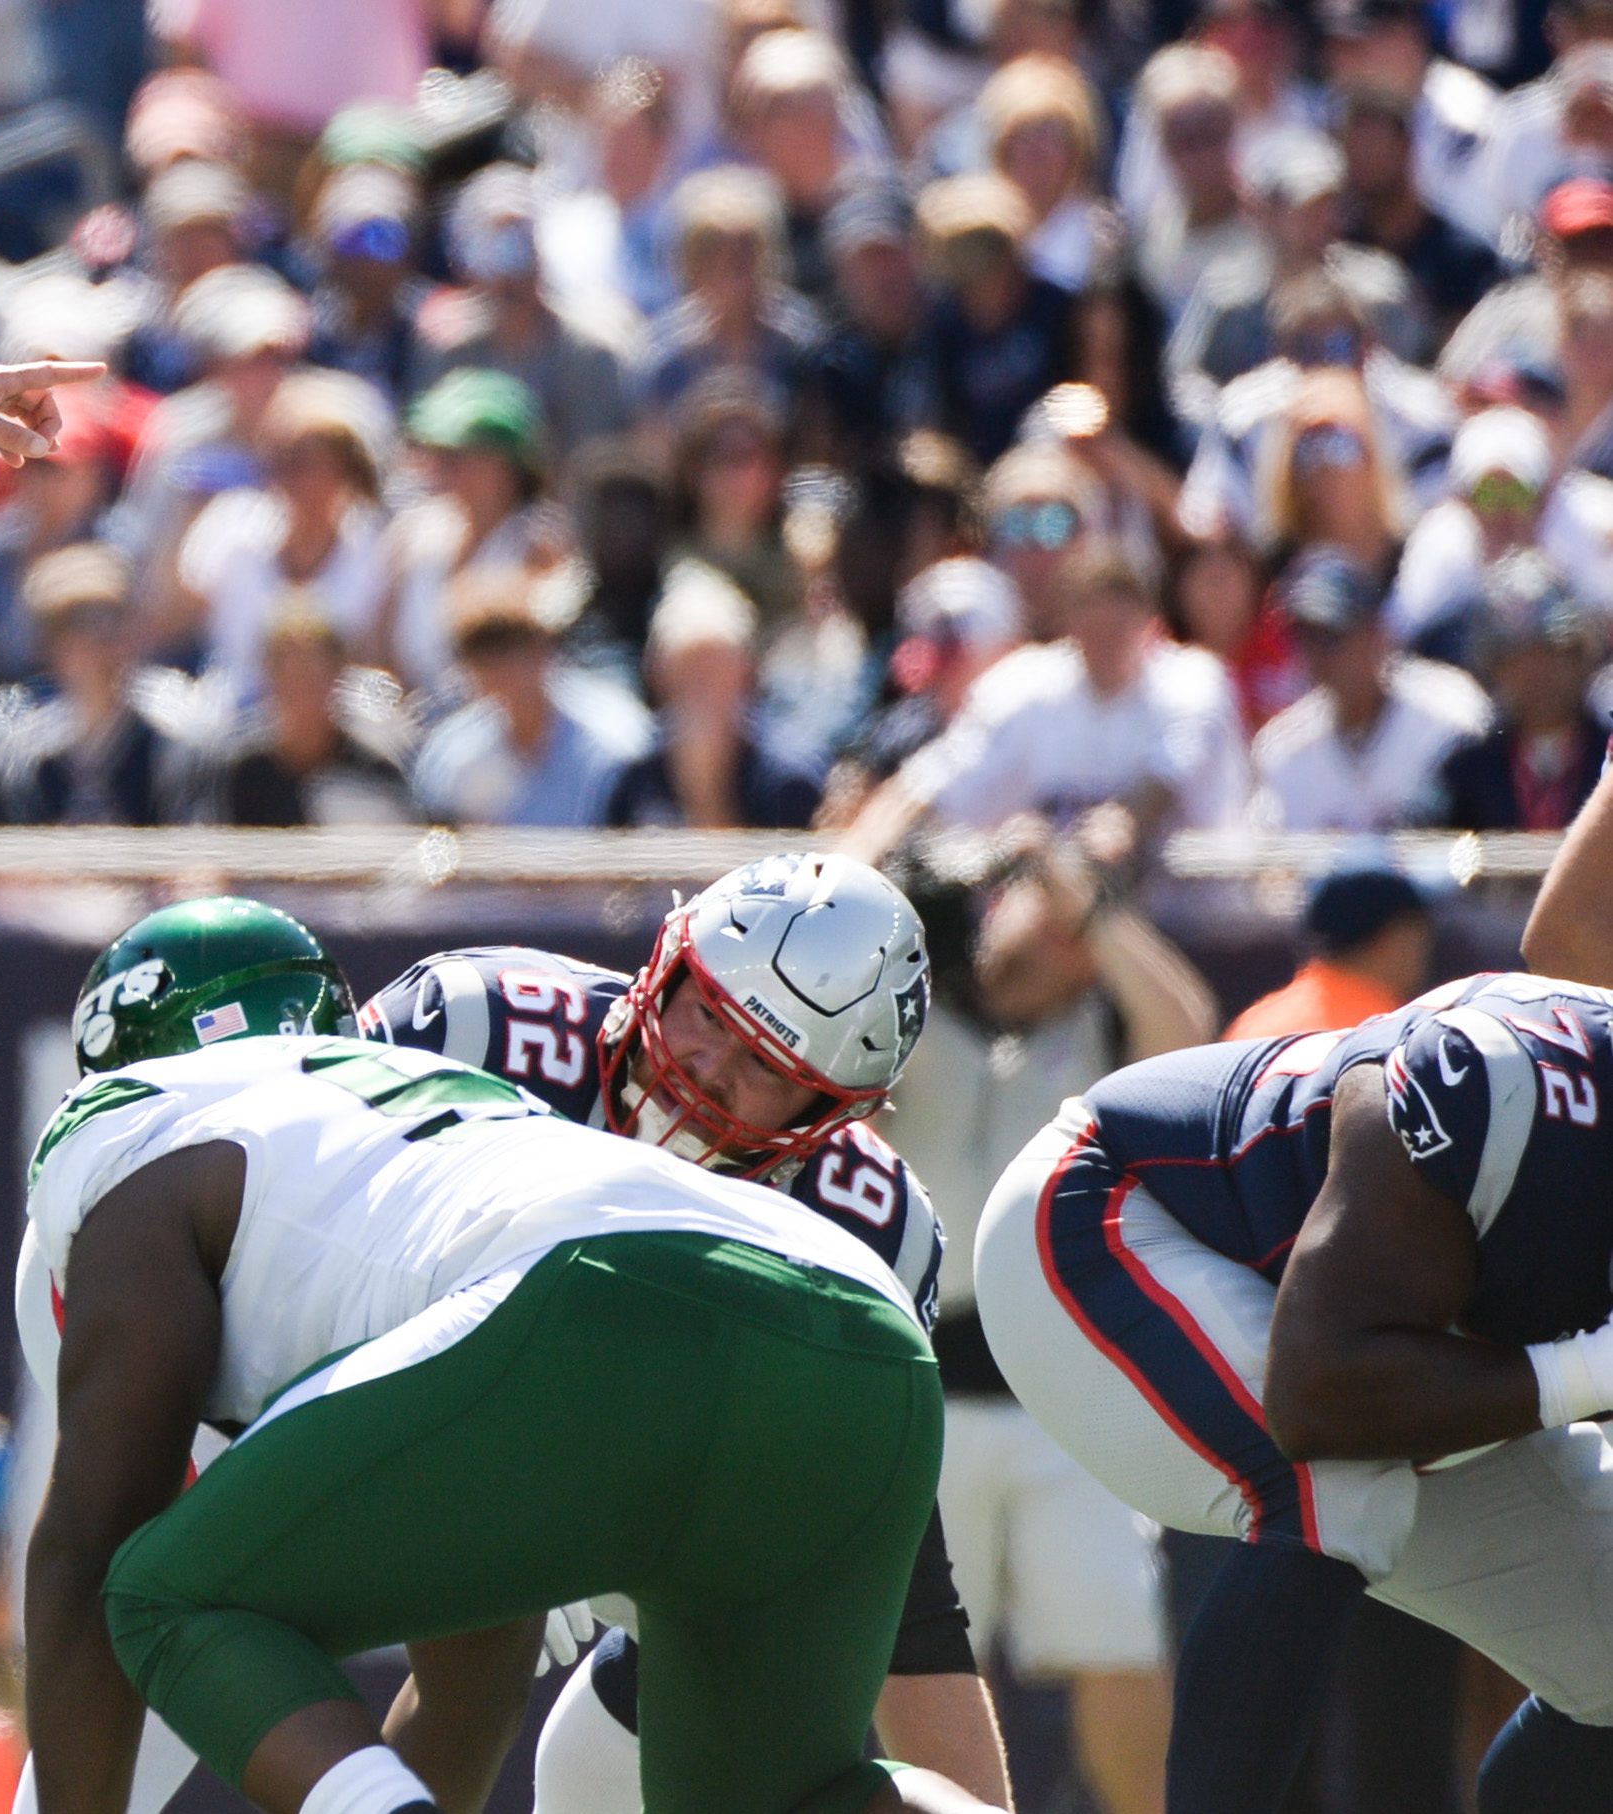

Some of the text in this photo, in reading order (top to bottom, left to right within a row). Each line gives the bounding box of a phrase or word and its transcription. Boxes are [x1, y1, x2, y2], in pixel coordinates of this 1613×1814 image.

[498, 969, 588, 1089] 62
[743, 995, 801, 1049] PATRIOTS
[1502, 1007, 1599, 1128] 72
